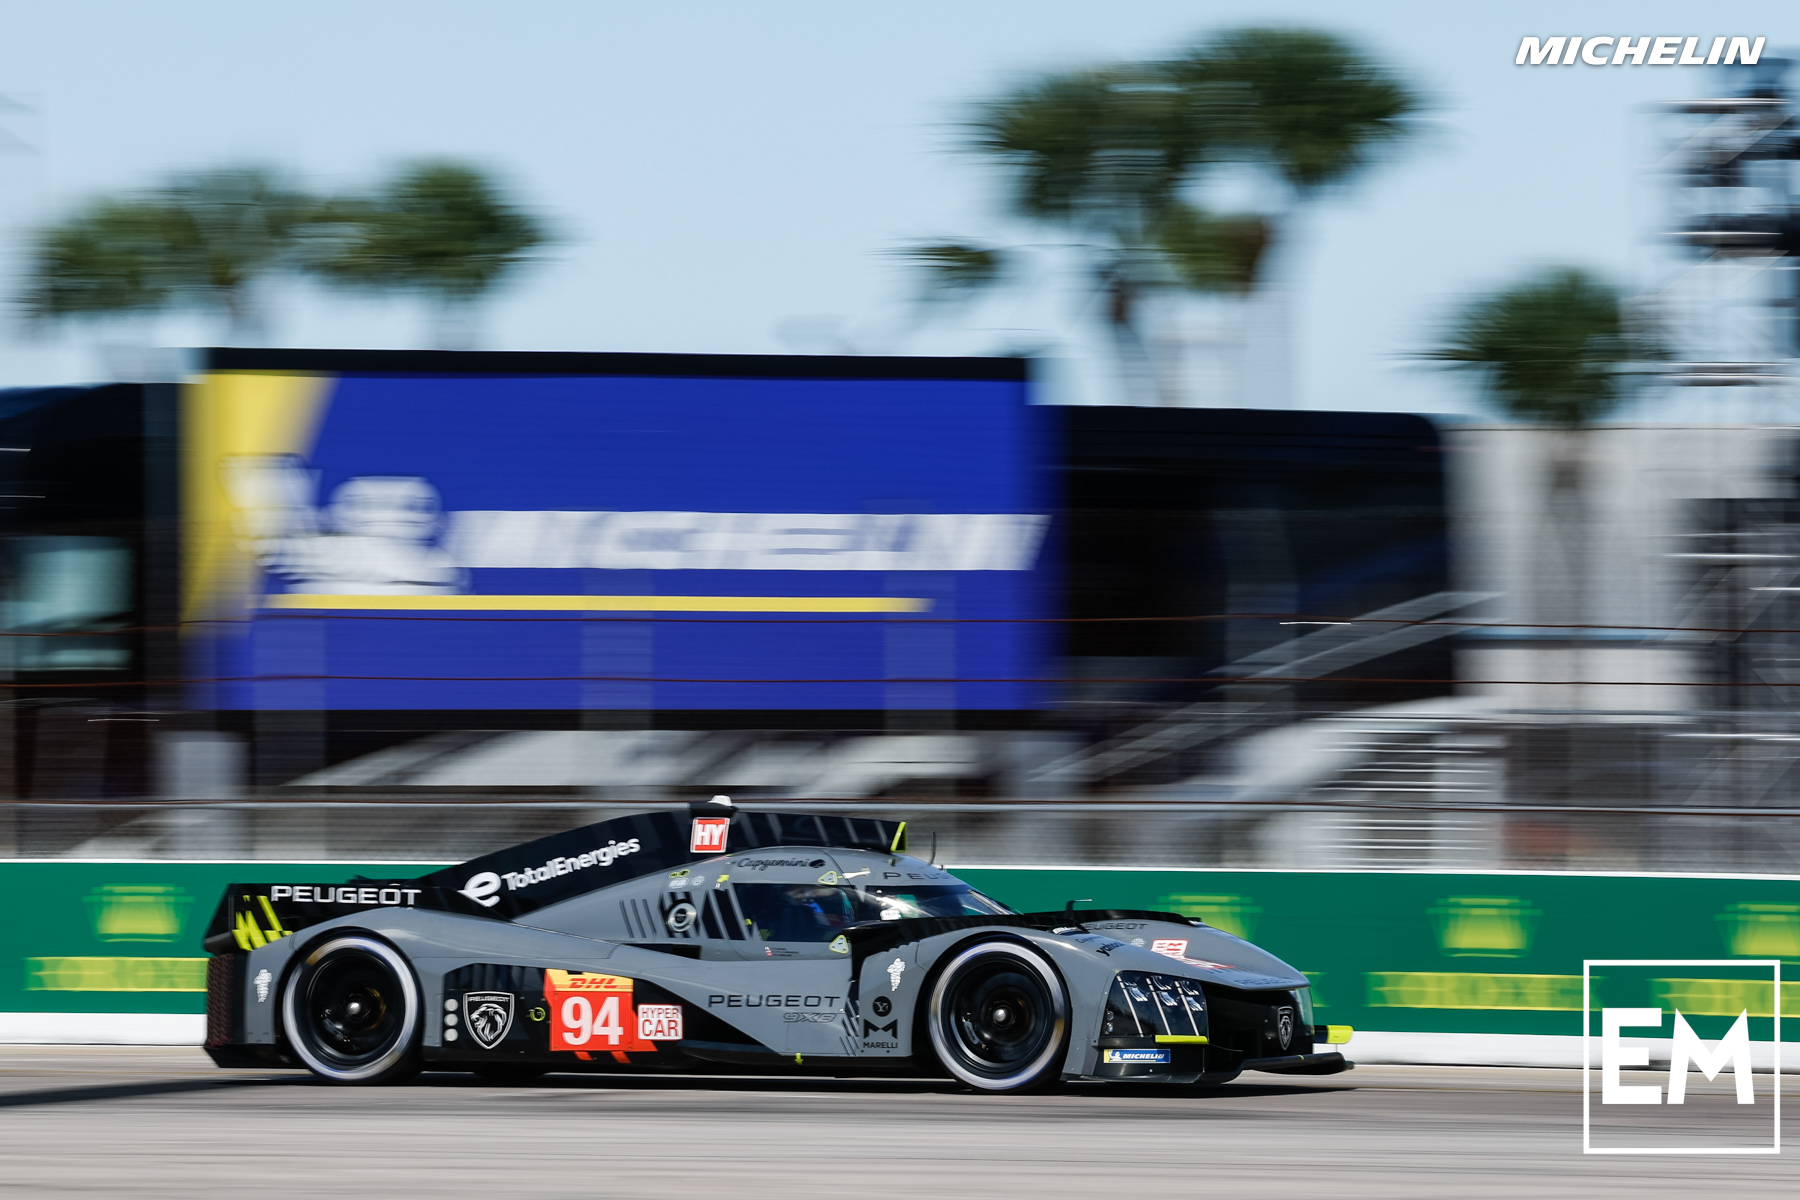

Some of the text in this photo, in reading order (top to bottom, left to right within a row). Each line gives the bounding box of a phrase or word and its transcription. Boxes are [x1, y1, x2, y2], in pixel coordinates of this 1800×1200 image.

[695, 824, 726, 846] HY
[501, 838, 640, 891] TotalEnergies
[737, 858, 809, 871] Capgemini
[883, 871, 953, 880] PEUG
[271, 886, 421, 906] PEUGEOT
[1083, 922, 1148, 931] EUGEOT
[569, 978, 617, 989] DHL
[708, 995, 841, 1008] PEUGEOT
[642, 1007, 679, 1018] HYPER
[783, 1012, 837, 1023] 9X8
[561, 996, 623, 1045] 94
[642, 1019, 679, 1037] CAR
[863, 1041, 898, 1049] MARELLI
